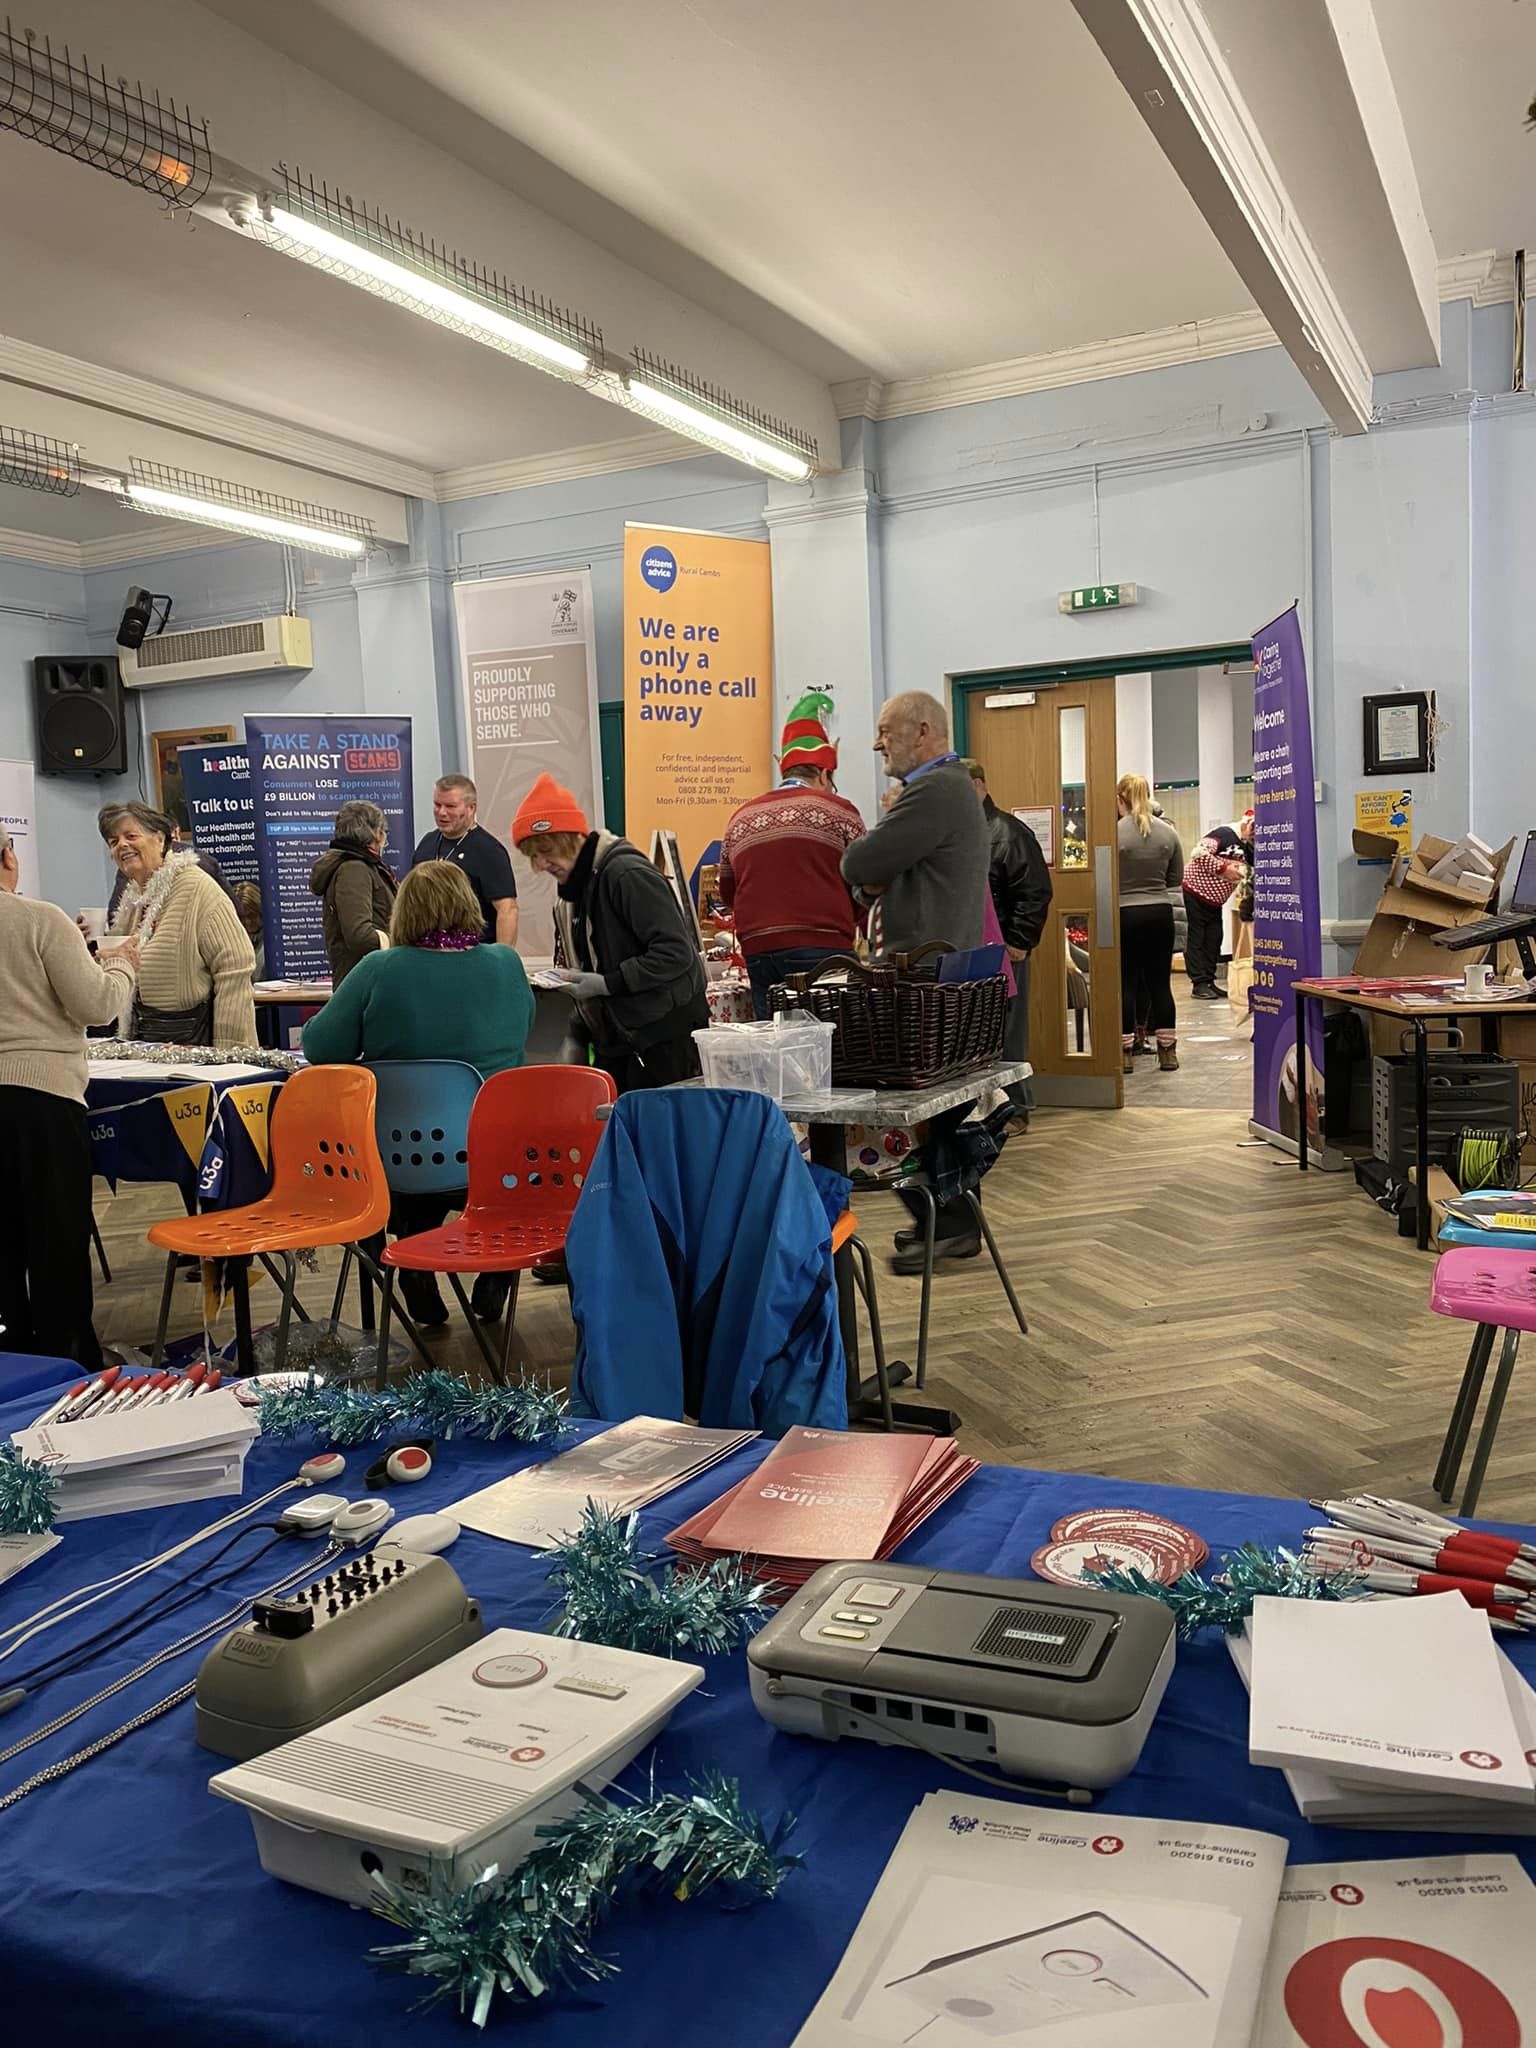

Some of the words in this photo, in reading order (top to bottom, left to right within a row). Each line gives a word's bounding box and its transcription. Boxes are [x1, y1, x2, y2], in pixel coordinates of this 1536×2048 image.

[646, 558, 673, 569] citizens
[648, 568, 671, 578] advice
[679, 566, 698, 575] Rural
[639, 617, 676, 639] We
[683, 624, 720, 643] are
[640, 646, 690, 674] only
[697, 653, 709, 669] a
[473, 666, 532, 686] PROUDLY
[640, 672, 712, 699] phone
[719, 677, 756, 698] call
[474, 683, 556, 704] SUPPORTING
[475, 705, 517, 722] THOSE
[521, 702, 551, 719] WHO
[640, 704, 702, 728] away
[1254, 708, 1285, 733] Welcome
[476, 723, 522, 740] SERVE.
[261, 734, 310, 749] TAKE
[317, 734, 330, 749] A
[337, 734, 399, 749] STAND
[262, 754, 341, 769] AGAINST
[351, 752, 397, 768] SCAMS
[662, 754, 674, 762] For
[656, 764, 701, 773] confidential
[702, 765, 717, 773] and
[718, 765, 751, 774] impartial
[263, 780, 313, 789] Consumers
[315, 779, 339, 788] LOSE
[341, 778, 401, 789] approximately
[674, 775, 698, 783] advice
[264, 793, 276, 801] £9
[279, 792, 315, 801] BILLION
[359, 792, 380, 800] each
[192, 799, 222, 813] Talk
[224, 798, 238, 811] to
[241, 799, 254, 810] us
[0, 817, 28, 825] PEOPLE
[195, 825, 208, 833] Our
[196, 834, 214, 843] local
[215, 833, 240, 842] health
[241, 832, 255, 841] and
[215, 843, 255, 854] champion.
[175, 1102, 201, 1120] u3a
[242, 1099, 264, 1116] u3a
[91, 1124, 115, 1141] u3a
[200, 1156, 223, 1190] u3a
[760, 1488, 885, 1507] Careline
[1386, 1746, 1454, 1762] Careline
[1037, 1836, 1088, 1848] Careline
[1170, 1850, 1213, 1861] 616200
[1218, 1856, 1254, 1868] 01553
[1418, 1886, 1465, 1898] 616200
[1468, 1885, 1508, 1896] 01553
[1278, 1893, 1328, 1903] Carelin
